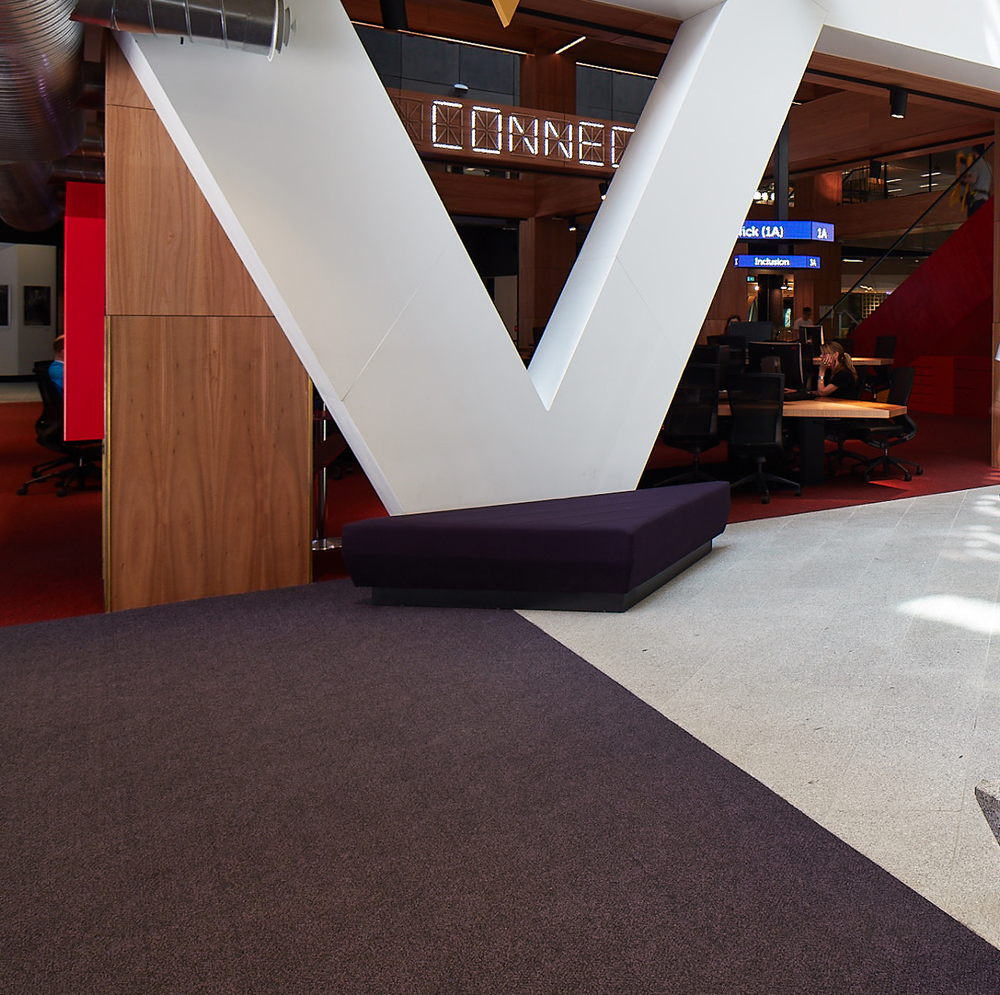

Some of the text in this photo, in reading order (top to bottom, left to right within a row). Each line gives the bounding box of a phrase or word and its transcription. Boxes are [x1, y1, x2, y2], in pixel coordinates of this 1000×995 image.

[761, 225, 784, 238] (1A)
[817, 227, 828, 239] 1A
[754, 257, 790, 266] Inclusion
